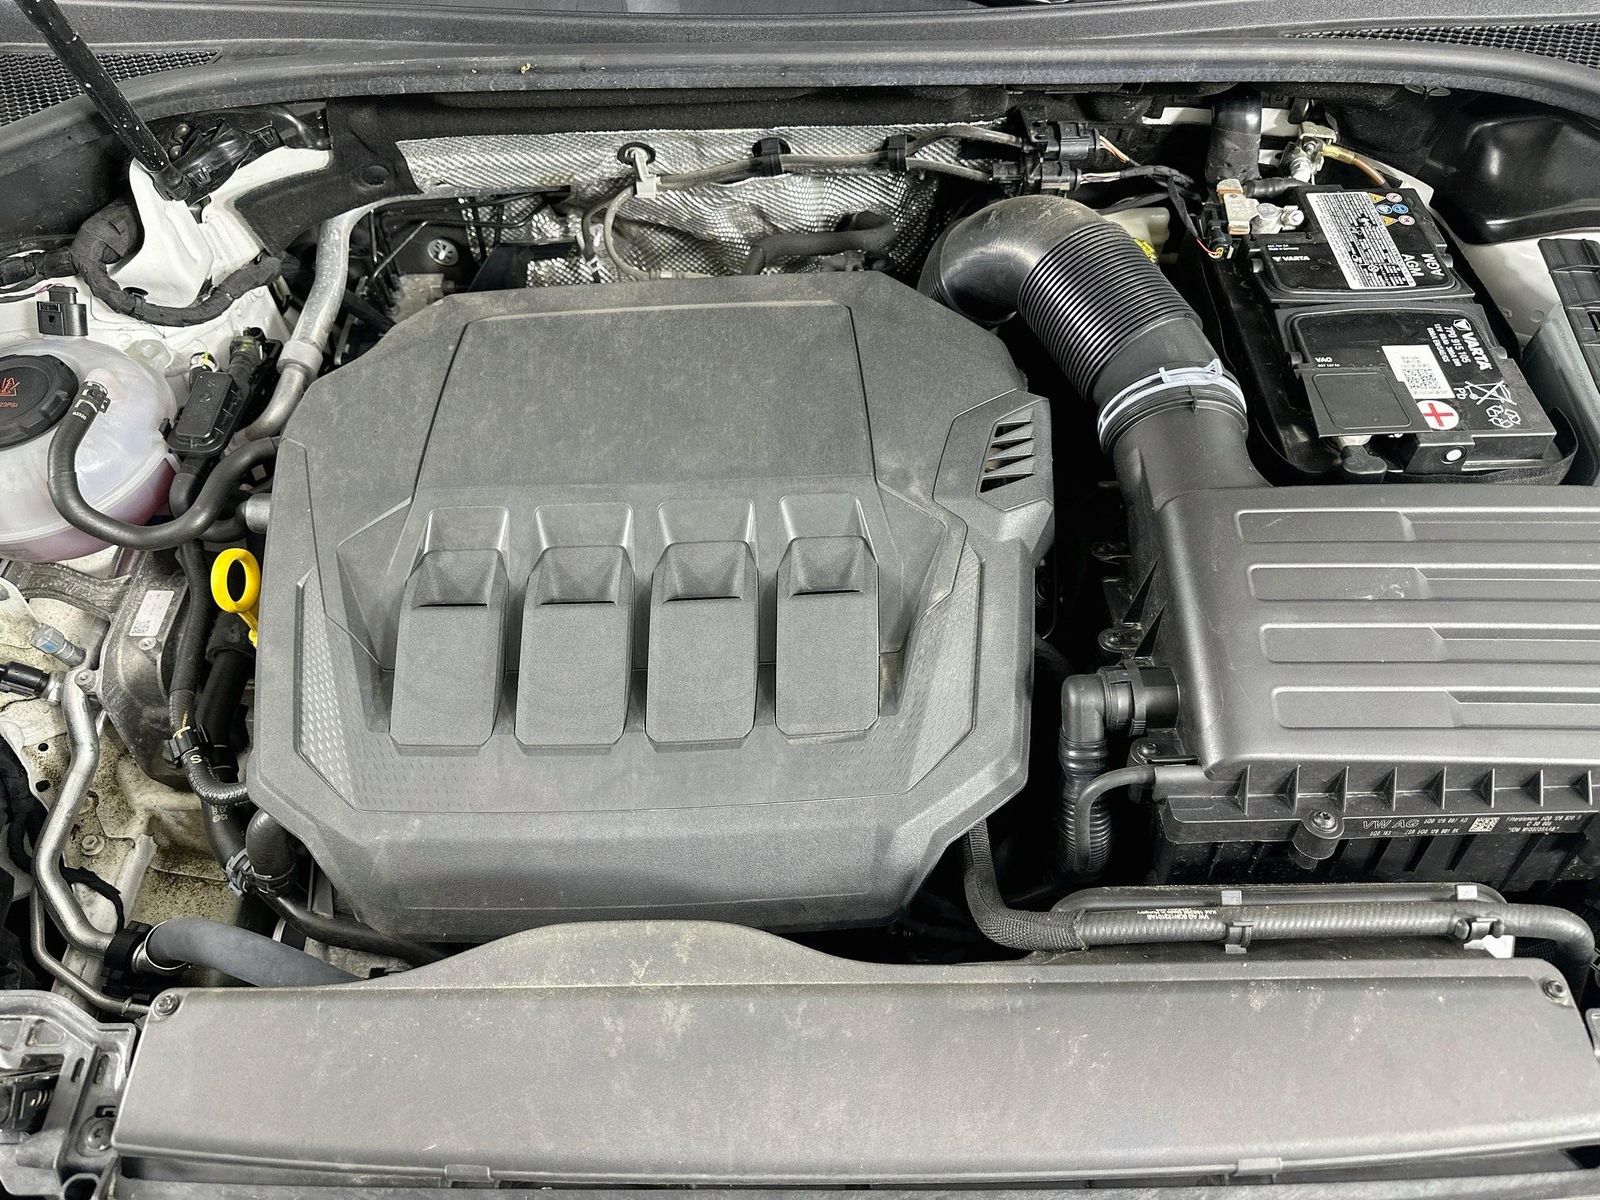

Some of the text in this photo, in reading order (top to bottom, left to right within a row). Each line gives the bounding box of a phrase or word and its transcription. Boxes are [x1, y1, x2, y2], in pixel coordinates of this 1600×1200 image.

[1401, 254, 1424, 277] AGM
[1421, 253, 1445, 277] AGM
[1451, 338, 1464, 352] 915
[1461, 331, 1492, 371] VARTA
[1454, 388, 1467, 399] Pb
[190, 754, 202, 763] S
[1362, 819, 1391, 830] VW
[1392, 818, 1420, 829] AG
